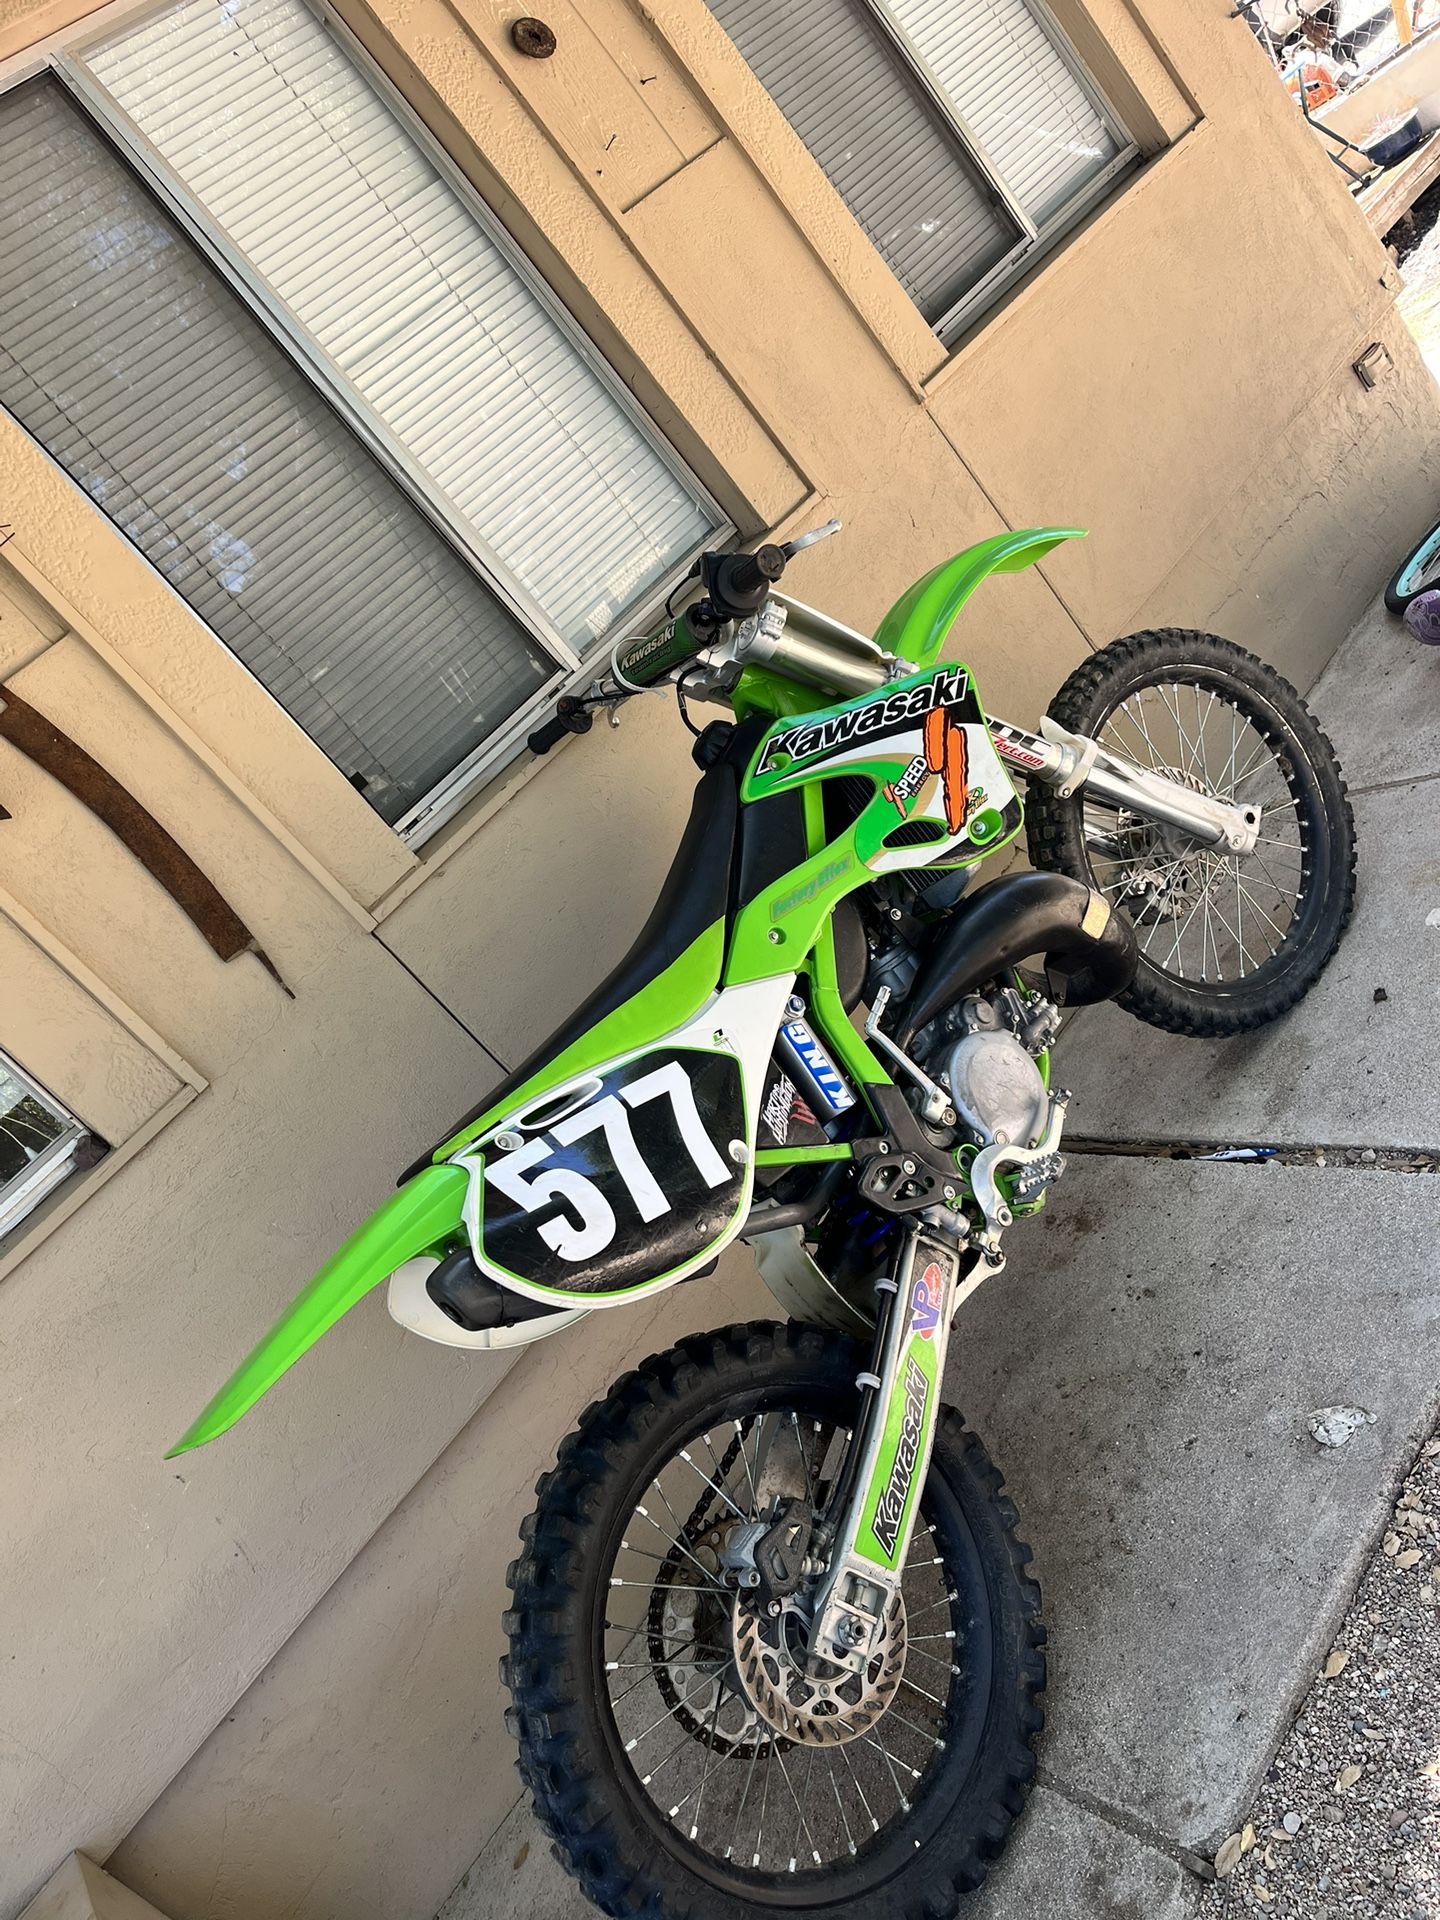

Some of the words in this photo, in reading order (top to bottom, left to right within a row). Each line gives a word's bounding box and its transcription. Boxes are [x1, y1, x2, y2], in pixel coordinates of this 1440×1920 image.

[621, 621, 677, 672] Kawasaki
[754, 667, 969, 777] Kawasaki
[985, 717, 1051, 756] DC
[894, 756, 927, 799] SPEED
[786, 1023, 856, 1109] KING
[484, 1061, 732, 1262] 577
[911, 1279, 940, 1332] VP
[872, 1352, 930, 1561] Kawasaki
